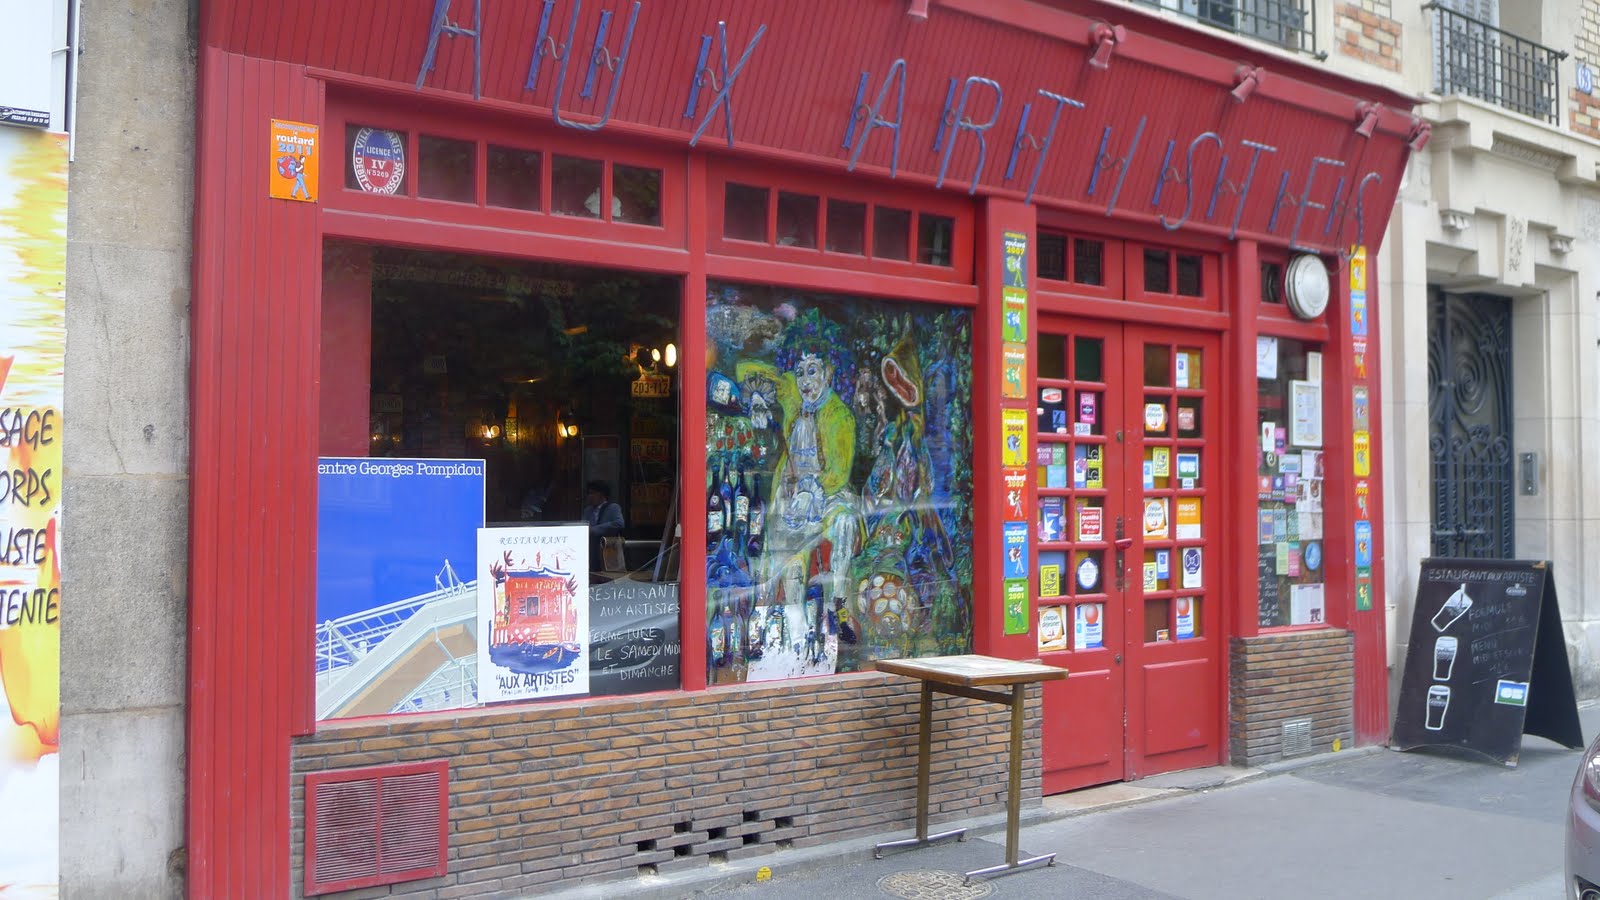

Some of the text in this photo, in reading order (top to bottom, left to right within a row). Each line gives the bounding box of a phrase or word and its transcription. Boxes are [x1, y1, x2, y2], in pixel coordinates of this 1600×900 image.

[415, 0, 1382, 261] AUX ARTISTES
[276, 134, 315, 147] routard
[278, 142, 313, 157] 2011
[366, 146, 392, 157] LICENCE
[355, 157, 369, 183] DEBIT
[371, 159, 386, 170] IV
[0, 407, 54, 450] SAGE
[317, 462, 482, 478] entre Georges Pompidou
[500, 535, 568, 545] RESTAURANT
[589, 582, 679, 602] RESTAURANT
[600, 602, 680, 617] AUX ARTISTES
[597, 647, 613, 661] LE
[620, 644, 661, 660] SAMEDI
[602, 662, 674, 681] ET DIMANCHE
